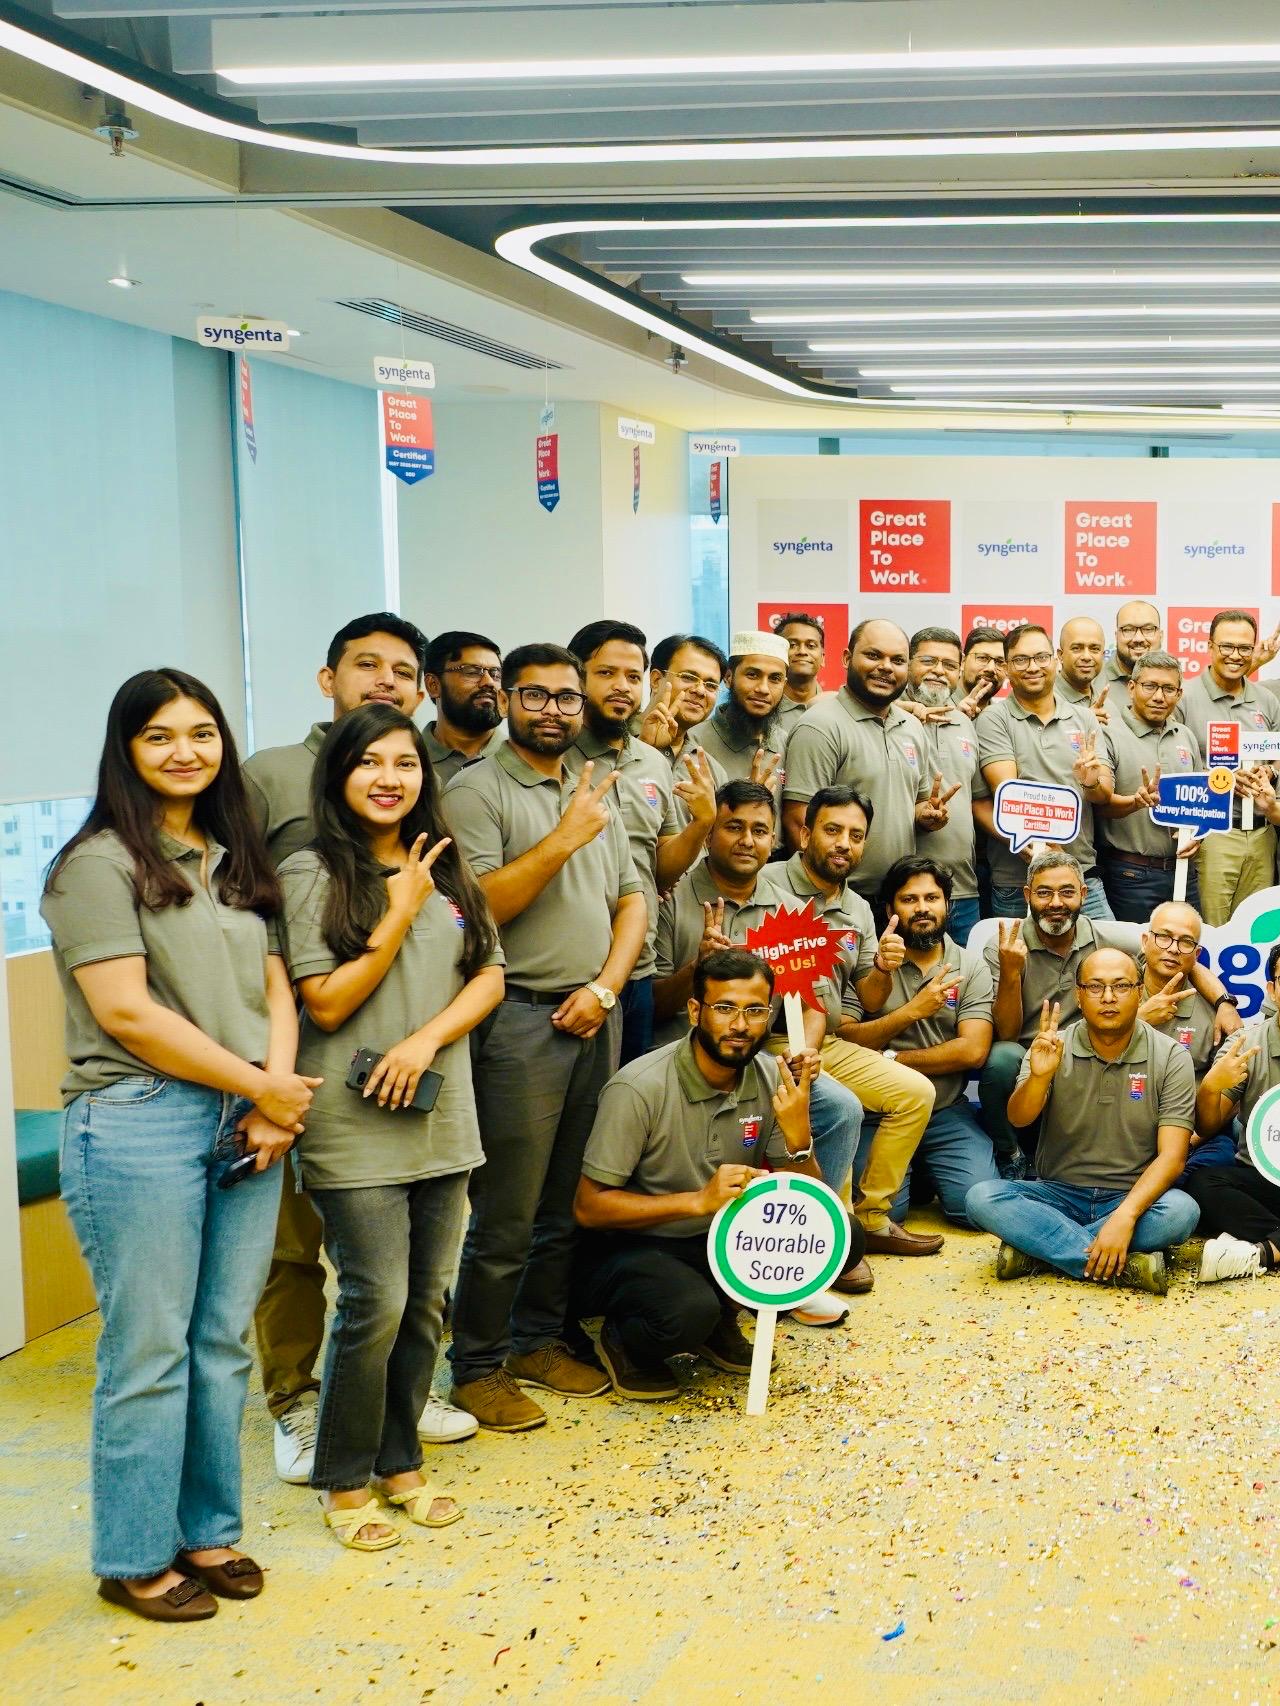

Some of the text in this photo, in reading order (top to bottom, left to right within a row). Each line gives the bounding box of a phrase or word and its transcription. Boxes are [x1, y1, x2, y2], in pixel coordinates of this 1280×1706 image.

[203, 327, 283, 344] syngenta
[379, 366, 431, 382] syngenta
[388, 397, 417, 408] Great
[389, 408, 417, 420] Place
[389, 420, 401, 430] To
[390, 432, 416, 443] Work
[393, 450, 426, 460] Certified
[693, 442, 737, 453] syngenta
[871, 511, 926, 526] Great
[1076, 512, 1132, 528] Great
[871, 531, 924, 546] Place
[1077, 532, 1129, 547] Place
[772, 538, 833, 556] syngenta
[976, 538, 1039, 558] syngenta
[1183, 541, 1246, 559] syngenta
[870, 550, 892, 565] To
[1076, 552, 1098, 567] To
[871, 570, 919, 585] Work
[1076, 572, 1125, 586] Work
[1178, 617, 1211, 633] Gre
[1178, 638, 1208, 653] Pla
[1178, 657, 1201, 673] To
[1024, 792, 1040, 801] Proud
[1042, 794, 1048, 802] to
[1175, 784, 1209, 804] 100%
[1002, 802, 1074, 820] Great Place To Work
[1155, 804, 1226, 820] Survey Participation
[1024, 820, 1050, 831] Certified
[752, 936, 828, 961] High-Five
[790, 954, 816, 972] Us!
[762, 1203, 808, 1226] 97%
[736, 1230, 826, 1254] favorable
[749, 1260, 805, 1282] Score
